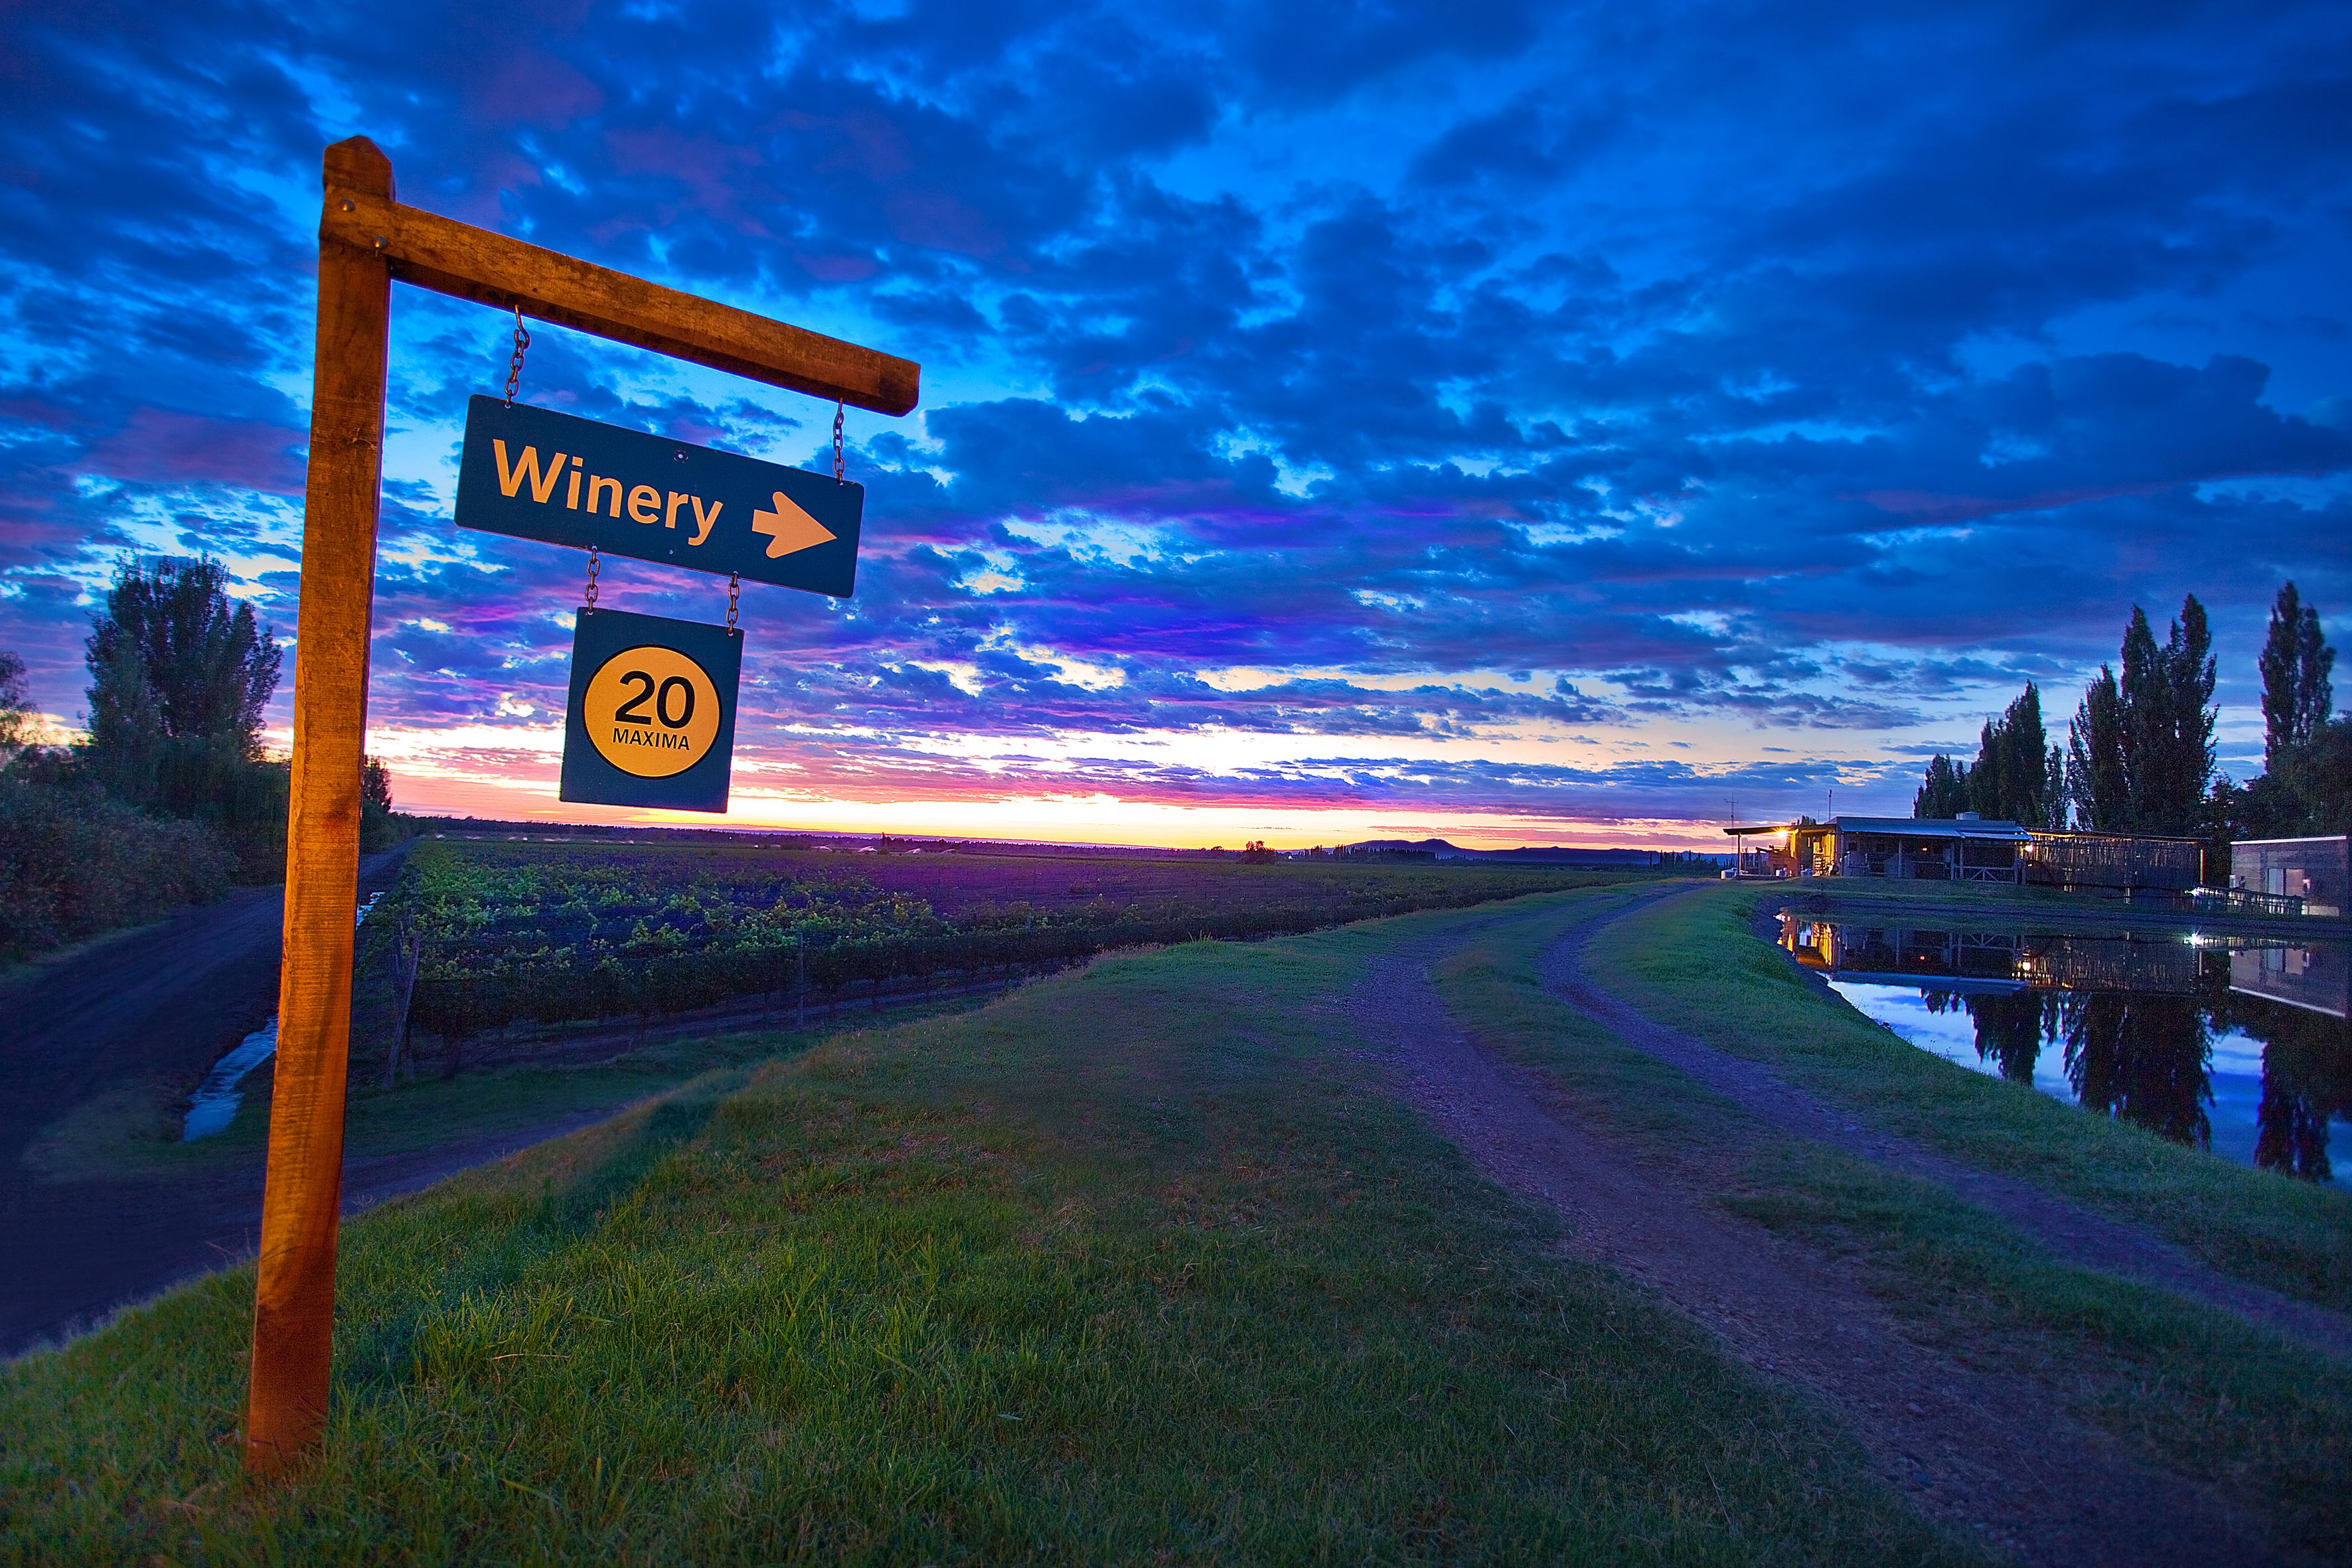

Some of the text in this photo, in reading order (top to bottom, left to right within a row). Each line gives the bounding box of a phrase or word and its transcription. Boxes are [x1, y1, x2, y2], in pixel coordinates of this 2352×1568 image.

[493, 438, 724, 546] Winery
[614, 670, 695, 729] 20
[611, 727, 690, 751] MAXIMA
